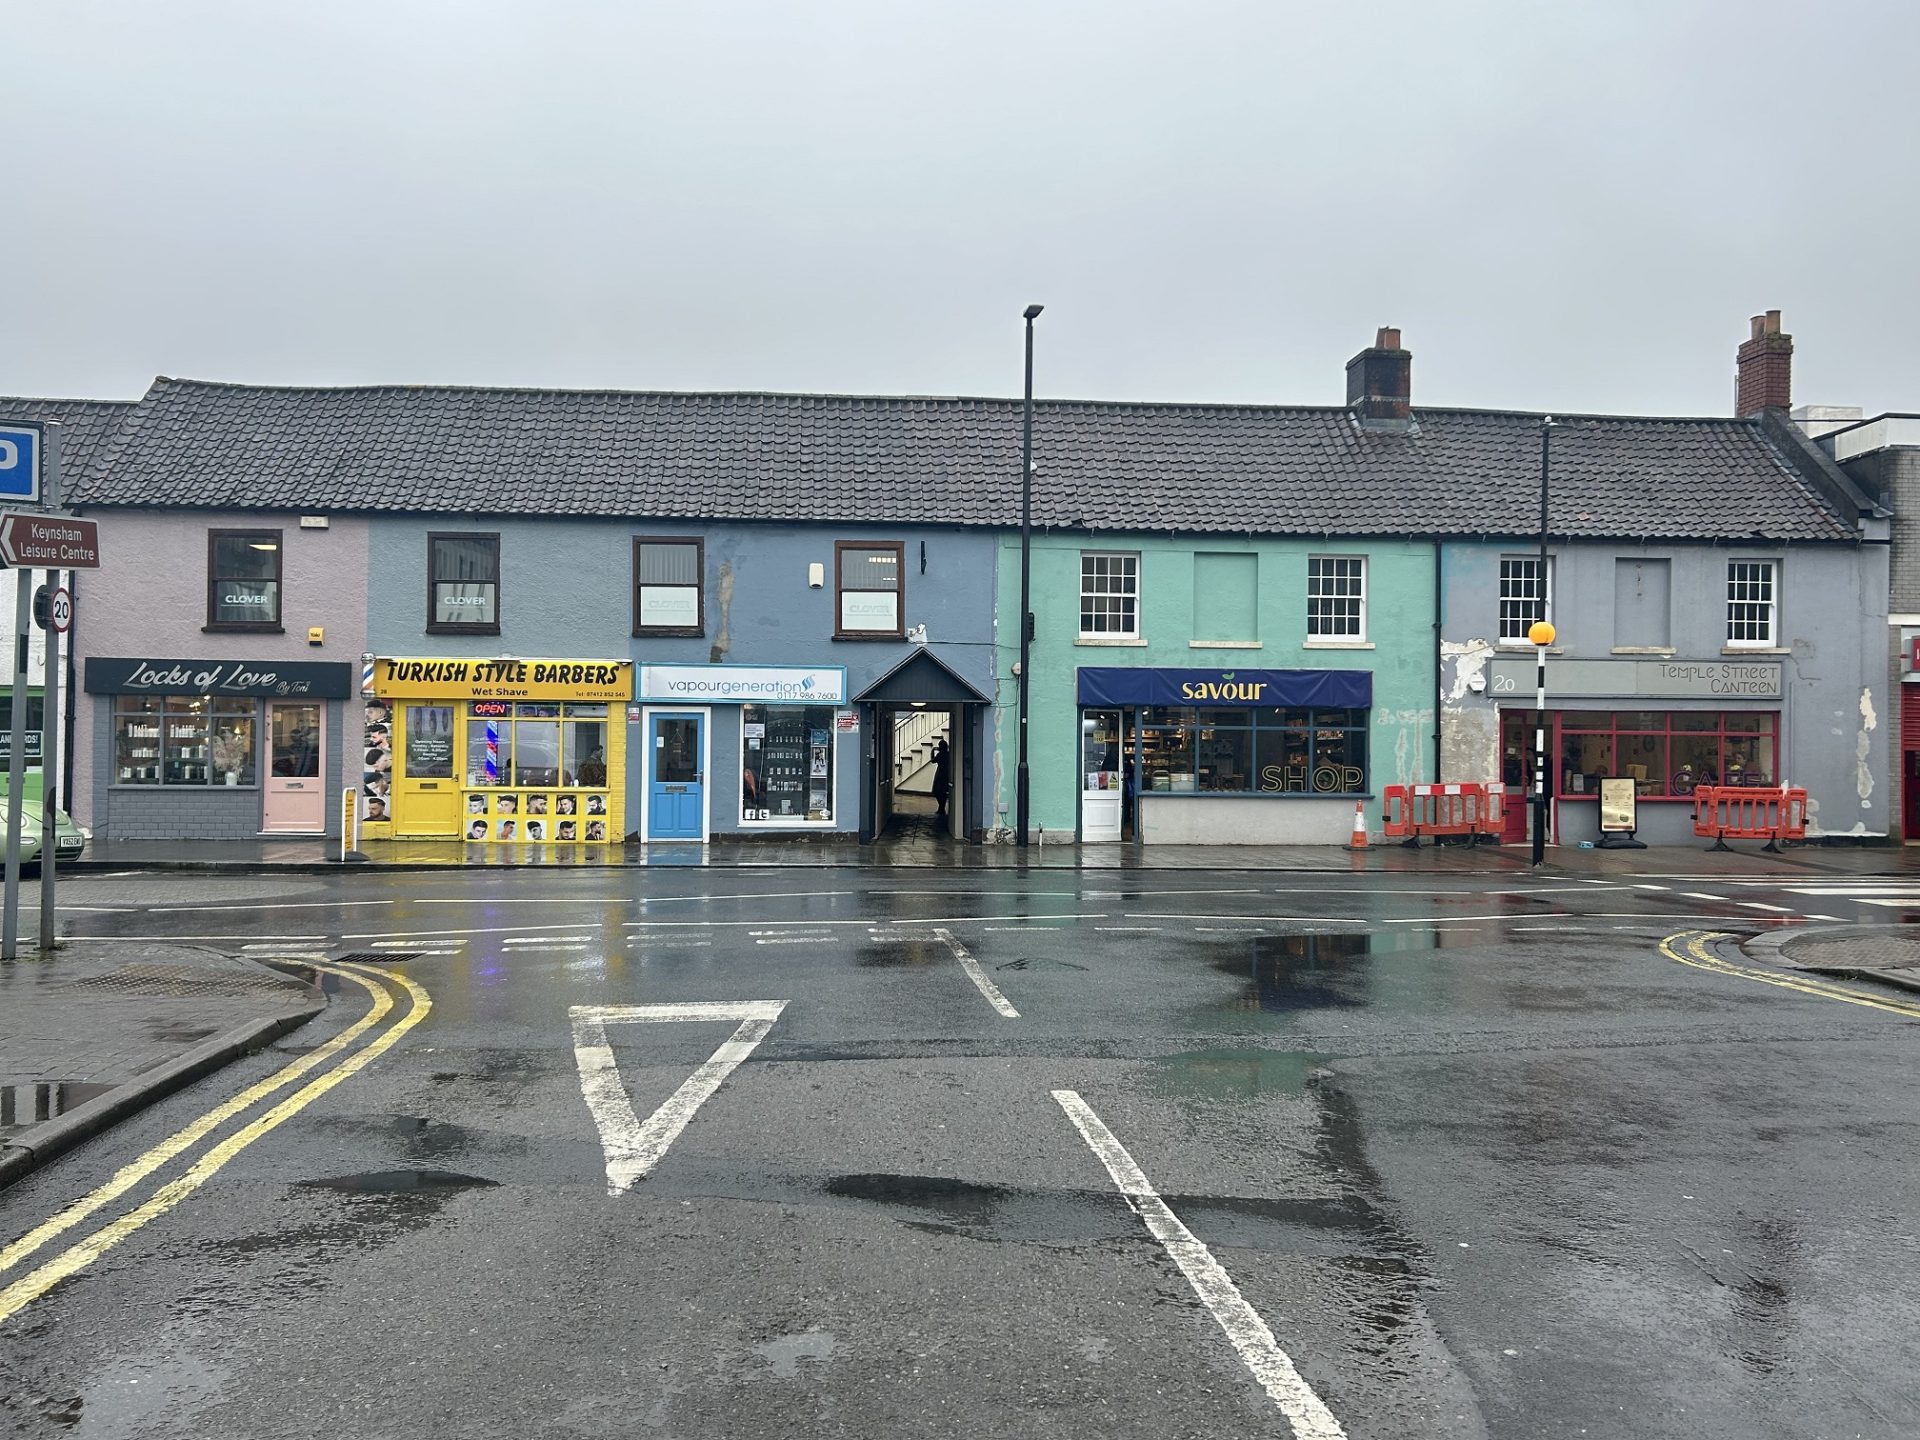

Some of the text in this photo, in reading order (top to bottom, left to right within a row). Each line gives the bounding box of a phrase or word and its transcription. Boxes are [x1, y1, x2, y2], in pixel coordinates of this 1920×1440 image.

[31, 523, 82, 542] Keynsham
[20, 542, 94, 561] Leisure Centre
[225, 595, 268, 603] CLOVER
[444, 596, 486, 605] CLOVER
[54, 601, 69, 620] 20
[123, 662, 277, 693] Locks of Love
[386, 661, 619, 685] TURKISH STYLE BARBERS
[472, 687, 529, 696] Wet Shave
[668, 680, 801, 694] vapourgeneration
[1182, 680, 1268, 701] savour
[1494, 674, 1515, 692] 20
[475, 704, 505, 714] OPEN
[1261, 765, 1364, 793] SHOP
